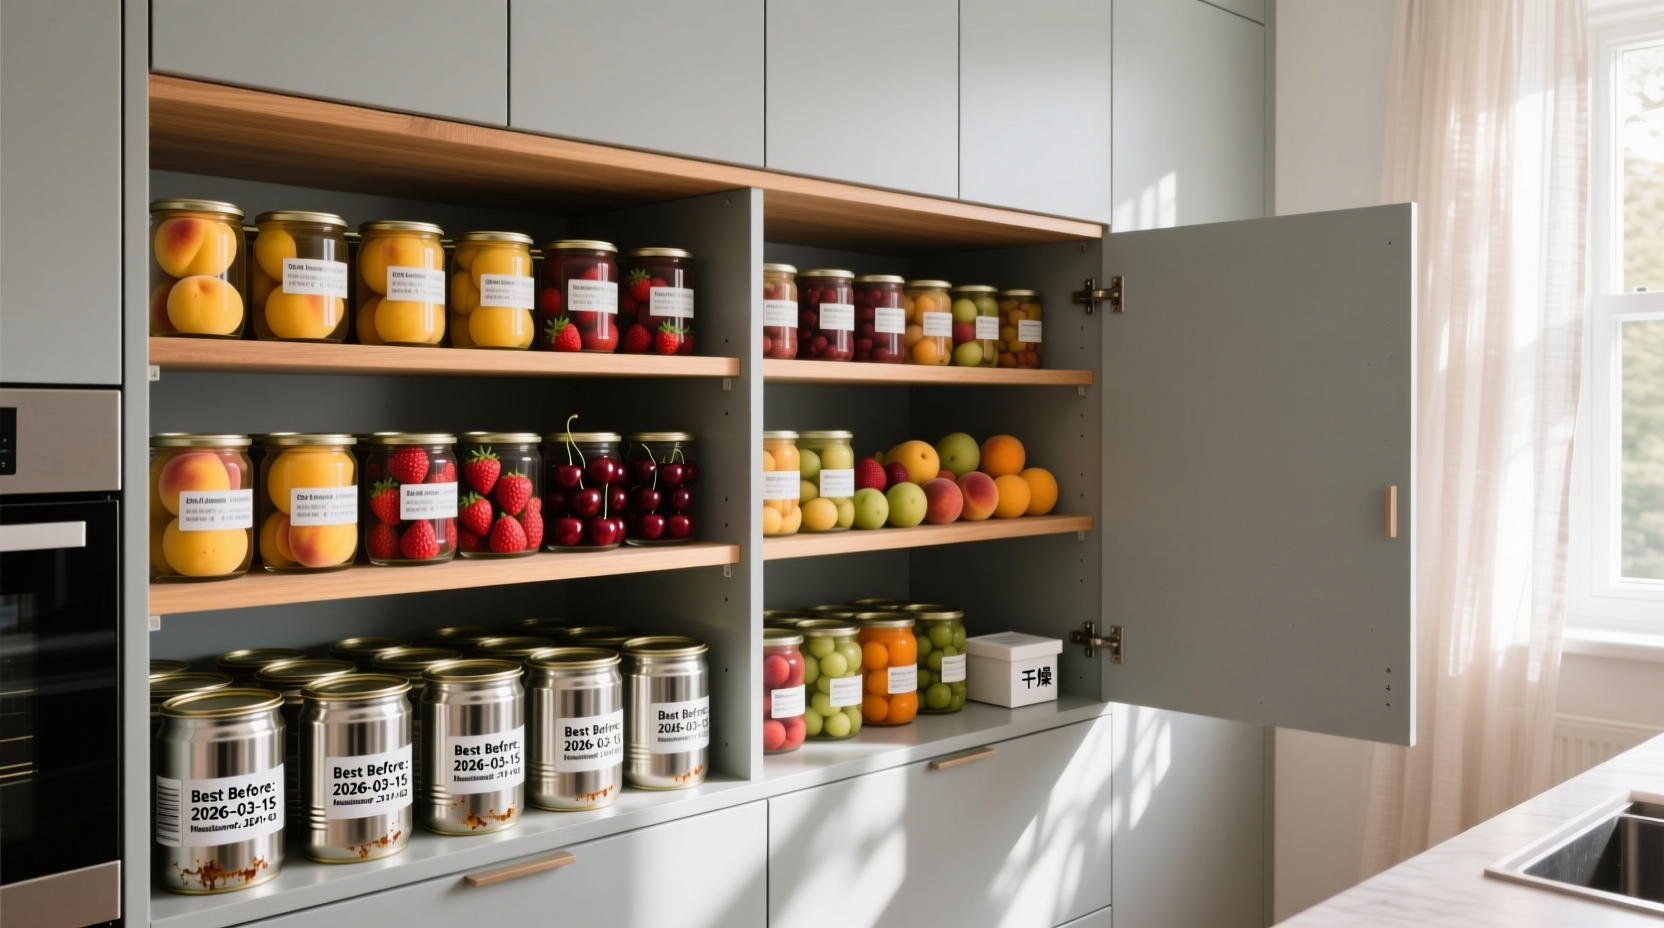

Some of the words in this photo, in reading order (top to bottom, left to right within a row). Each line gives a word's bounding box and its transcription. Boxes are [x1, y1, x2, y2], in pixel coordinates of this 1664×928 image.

[564, 726, 590, 737] Best
[454, 744, 481, 756] Best
[333, 766, 363, 779] Best
[191, 788, 224, 803] Best
[228, 781, 275, 800] Before:
[191, 796, 276, 821] 2026-03-15
